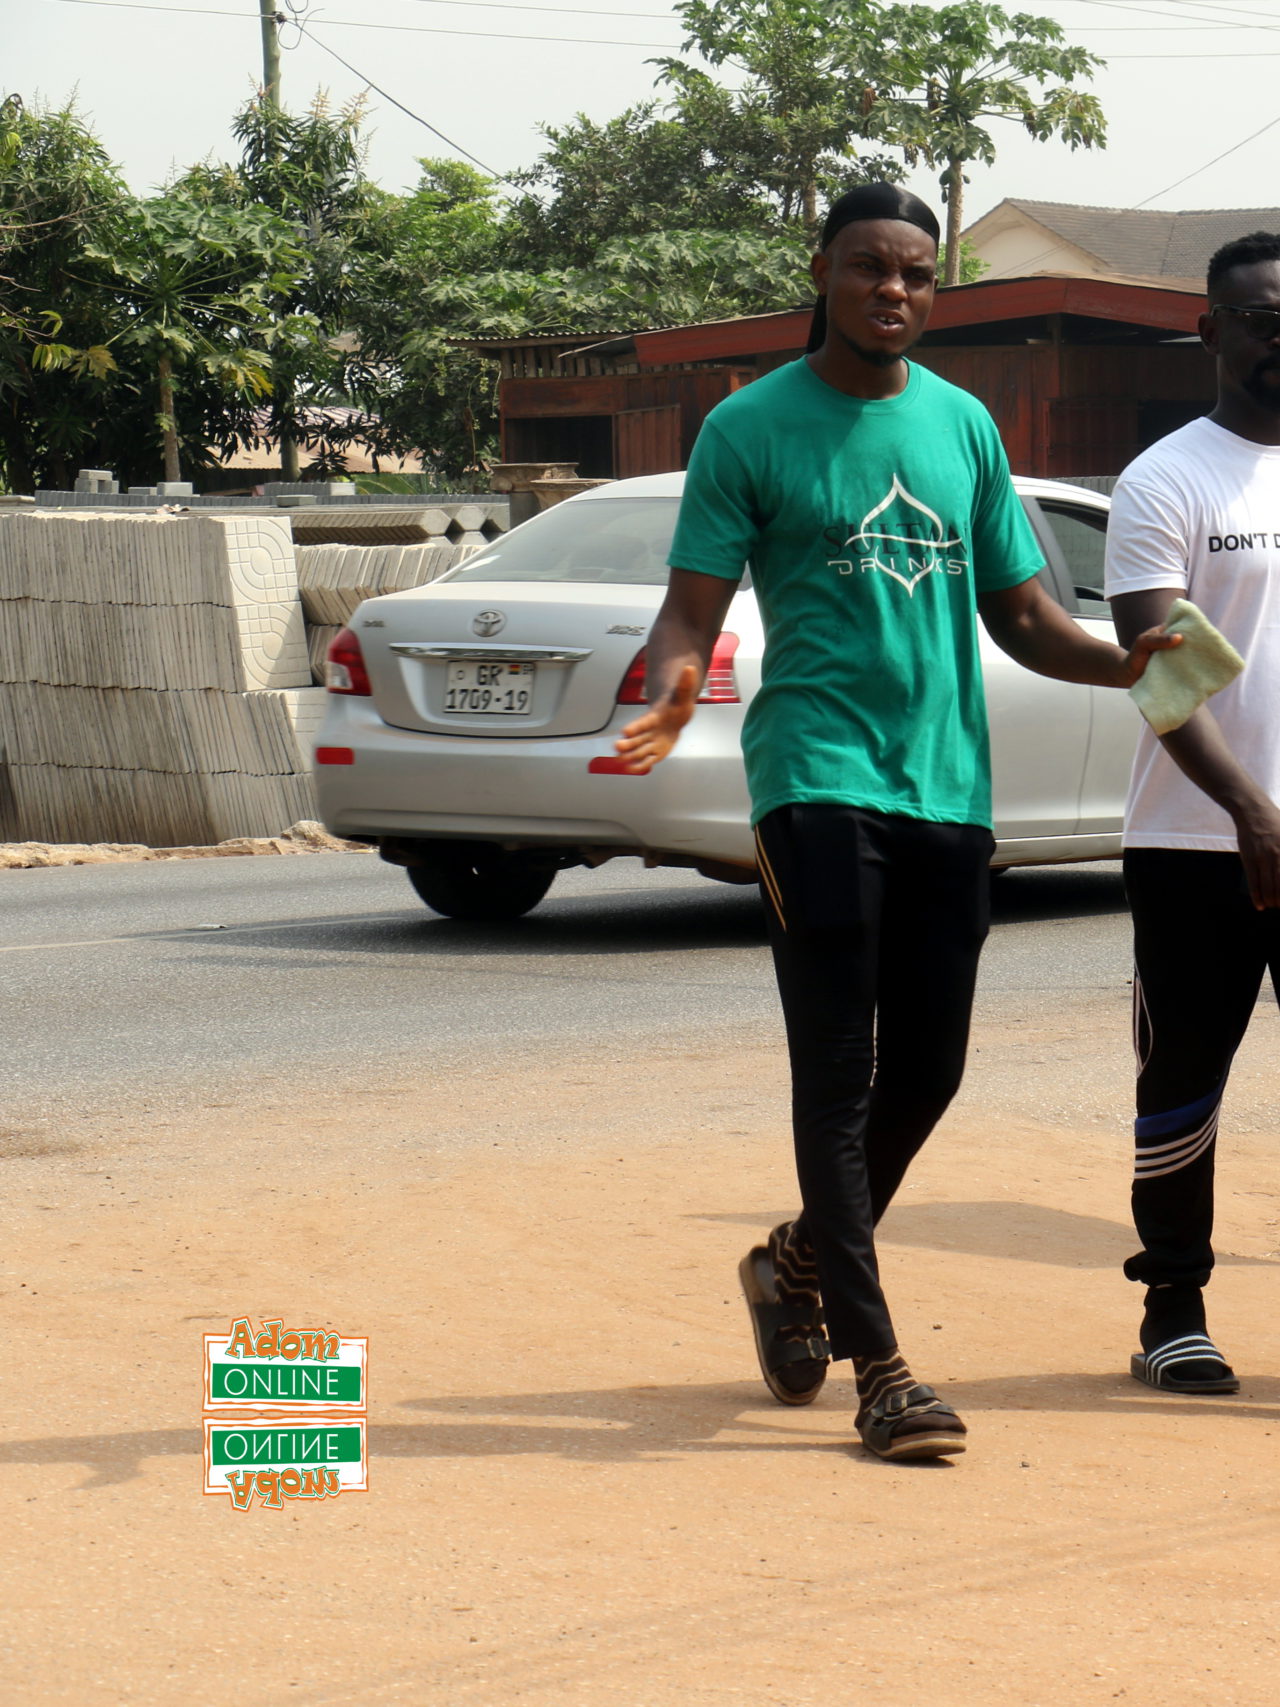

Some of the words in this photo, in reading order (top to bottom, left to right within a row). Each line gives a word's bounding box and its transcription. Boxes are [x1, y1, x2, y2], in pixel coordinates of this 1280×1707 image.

[1208, 532, 1269, 553] DON'T
[477, 664, 503, 686] GR
[446, 688, 529, 711] 1709-19
